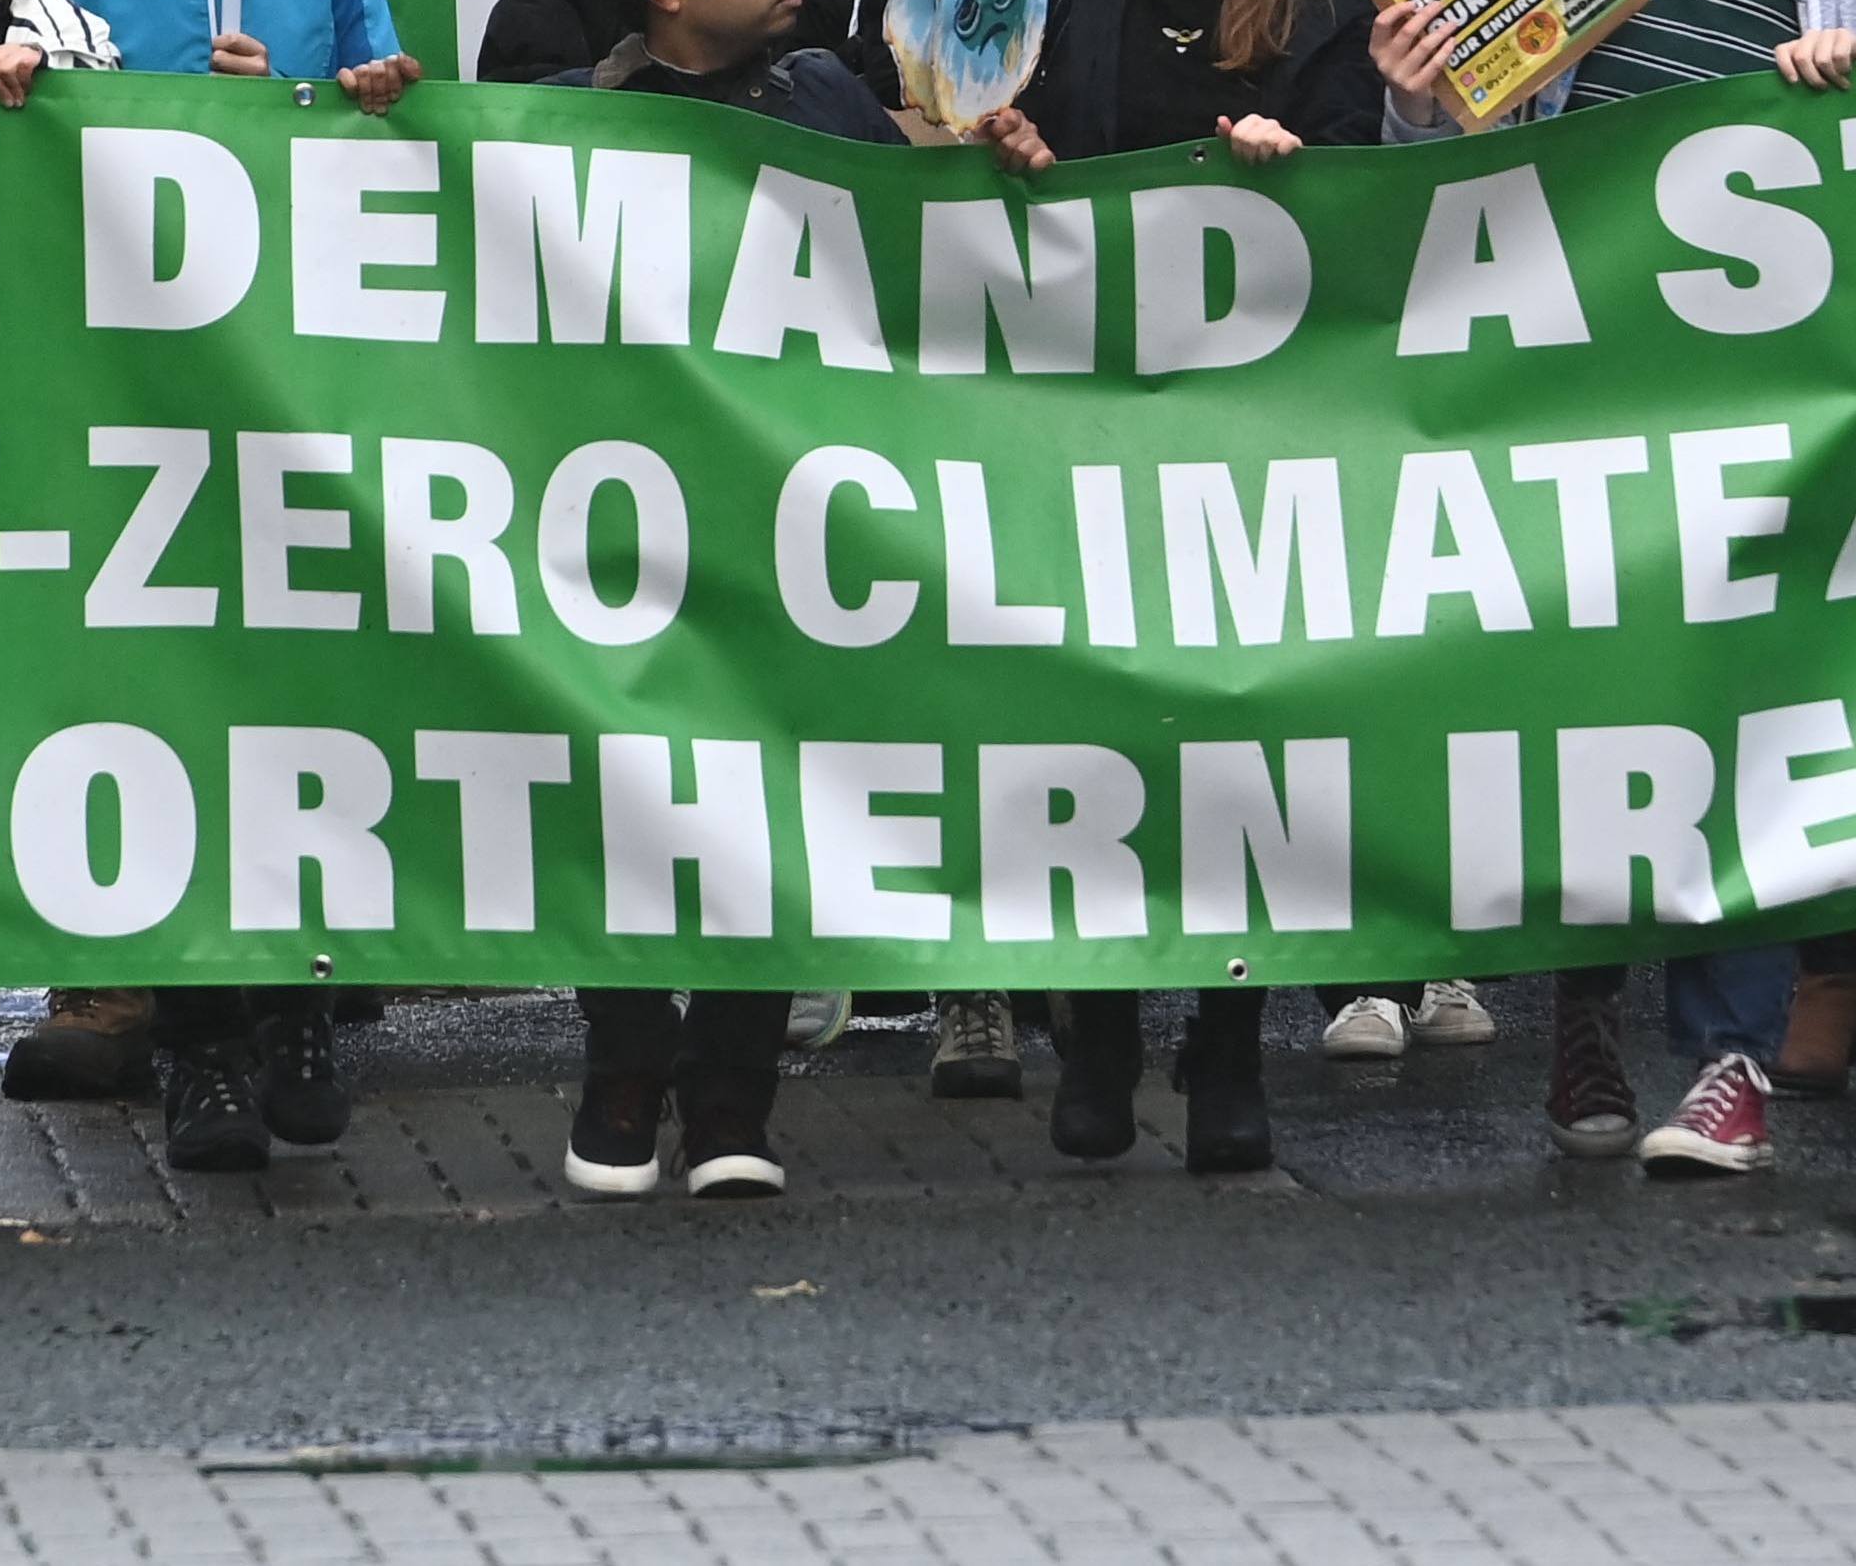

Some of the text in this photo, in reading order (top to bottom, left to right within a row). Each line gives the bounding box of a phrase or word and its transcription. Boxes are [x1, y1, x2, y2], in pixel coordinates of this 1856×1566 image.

[1447, 36, 1482, 67] OUR
[80, 126, 1313, 376] DEMAND
[1394, 163, 1593, 358] A
[774, 422, 1792, 649] CLIMATE
